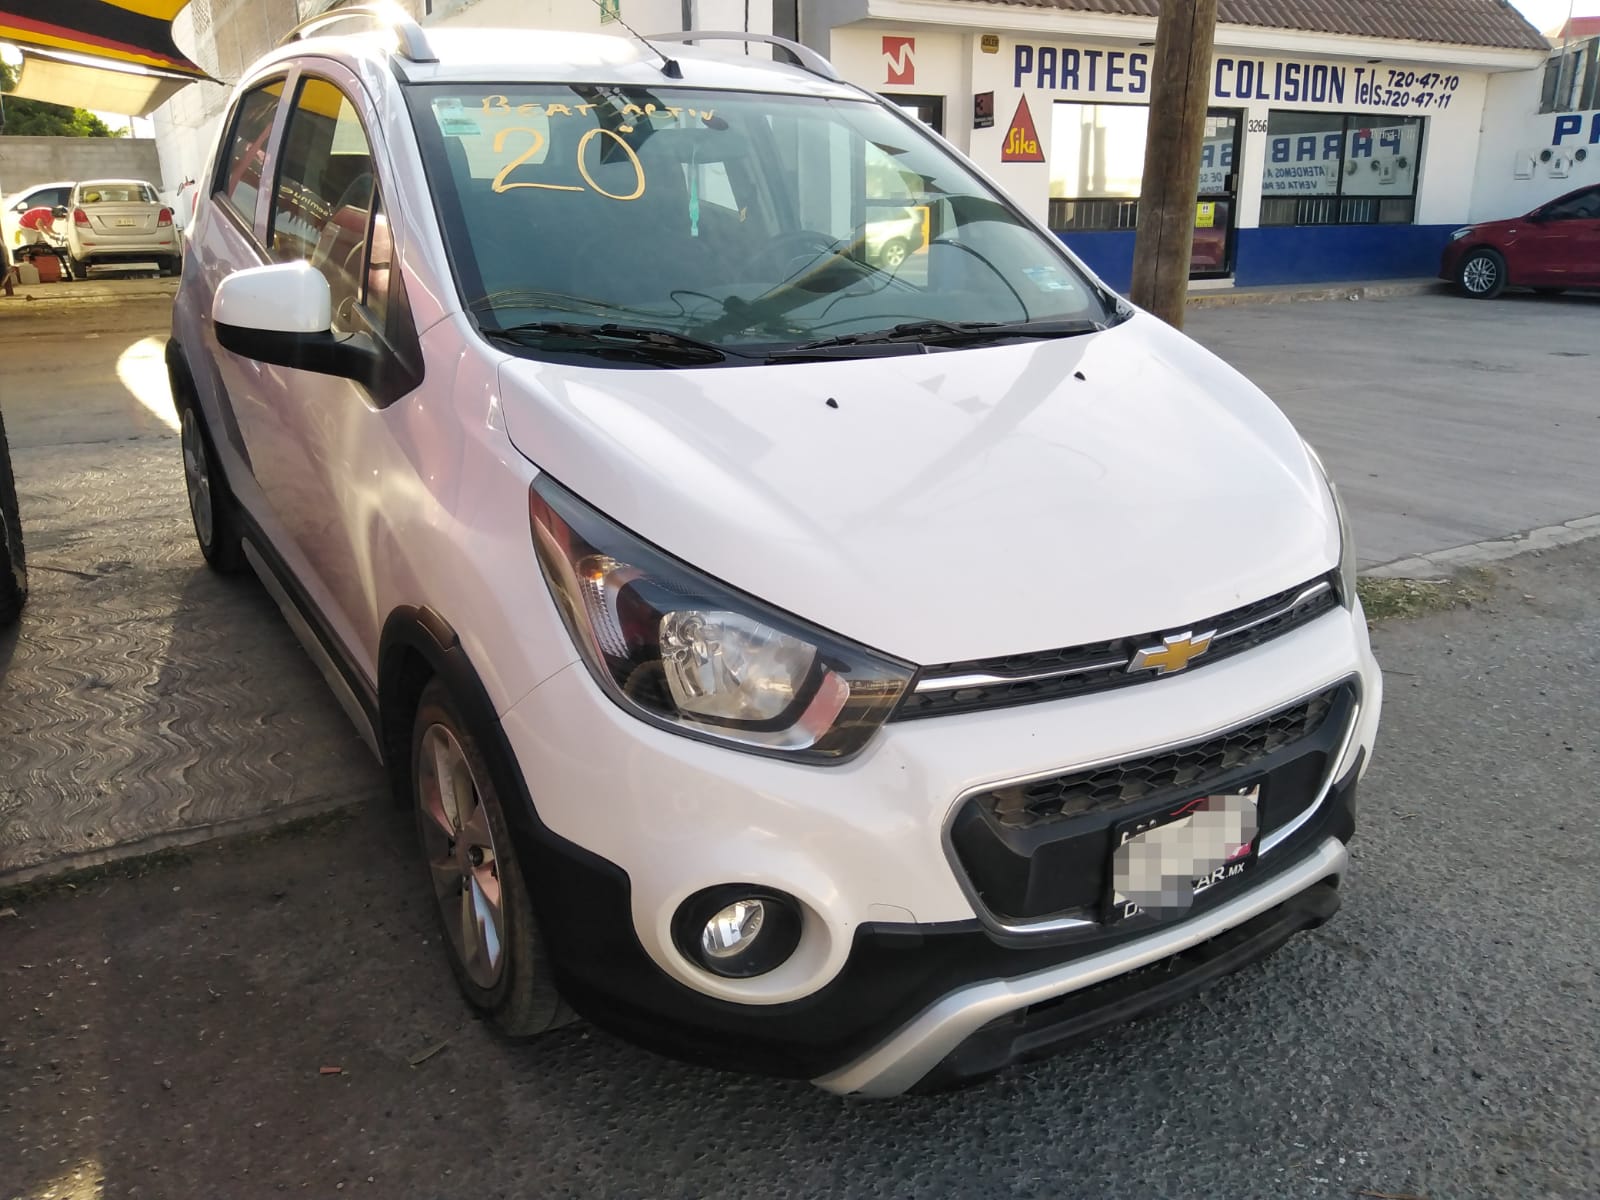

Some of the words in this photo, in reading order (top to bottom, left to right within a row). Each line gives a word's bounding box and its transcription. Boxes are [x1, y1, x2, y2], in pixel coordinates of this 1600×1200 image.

[1014, 45, 1148, 93] PARTES
[1214, 58, 1346, 104] COLISION
[1354, 67, 1386, 105] Tels.
[1005, 127, 1037, 154] Sika
